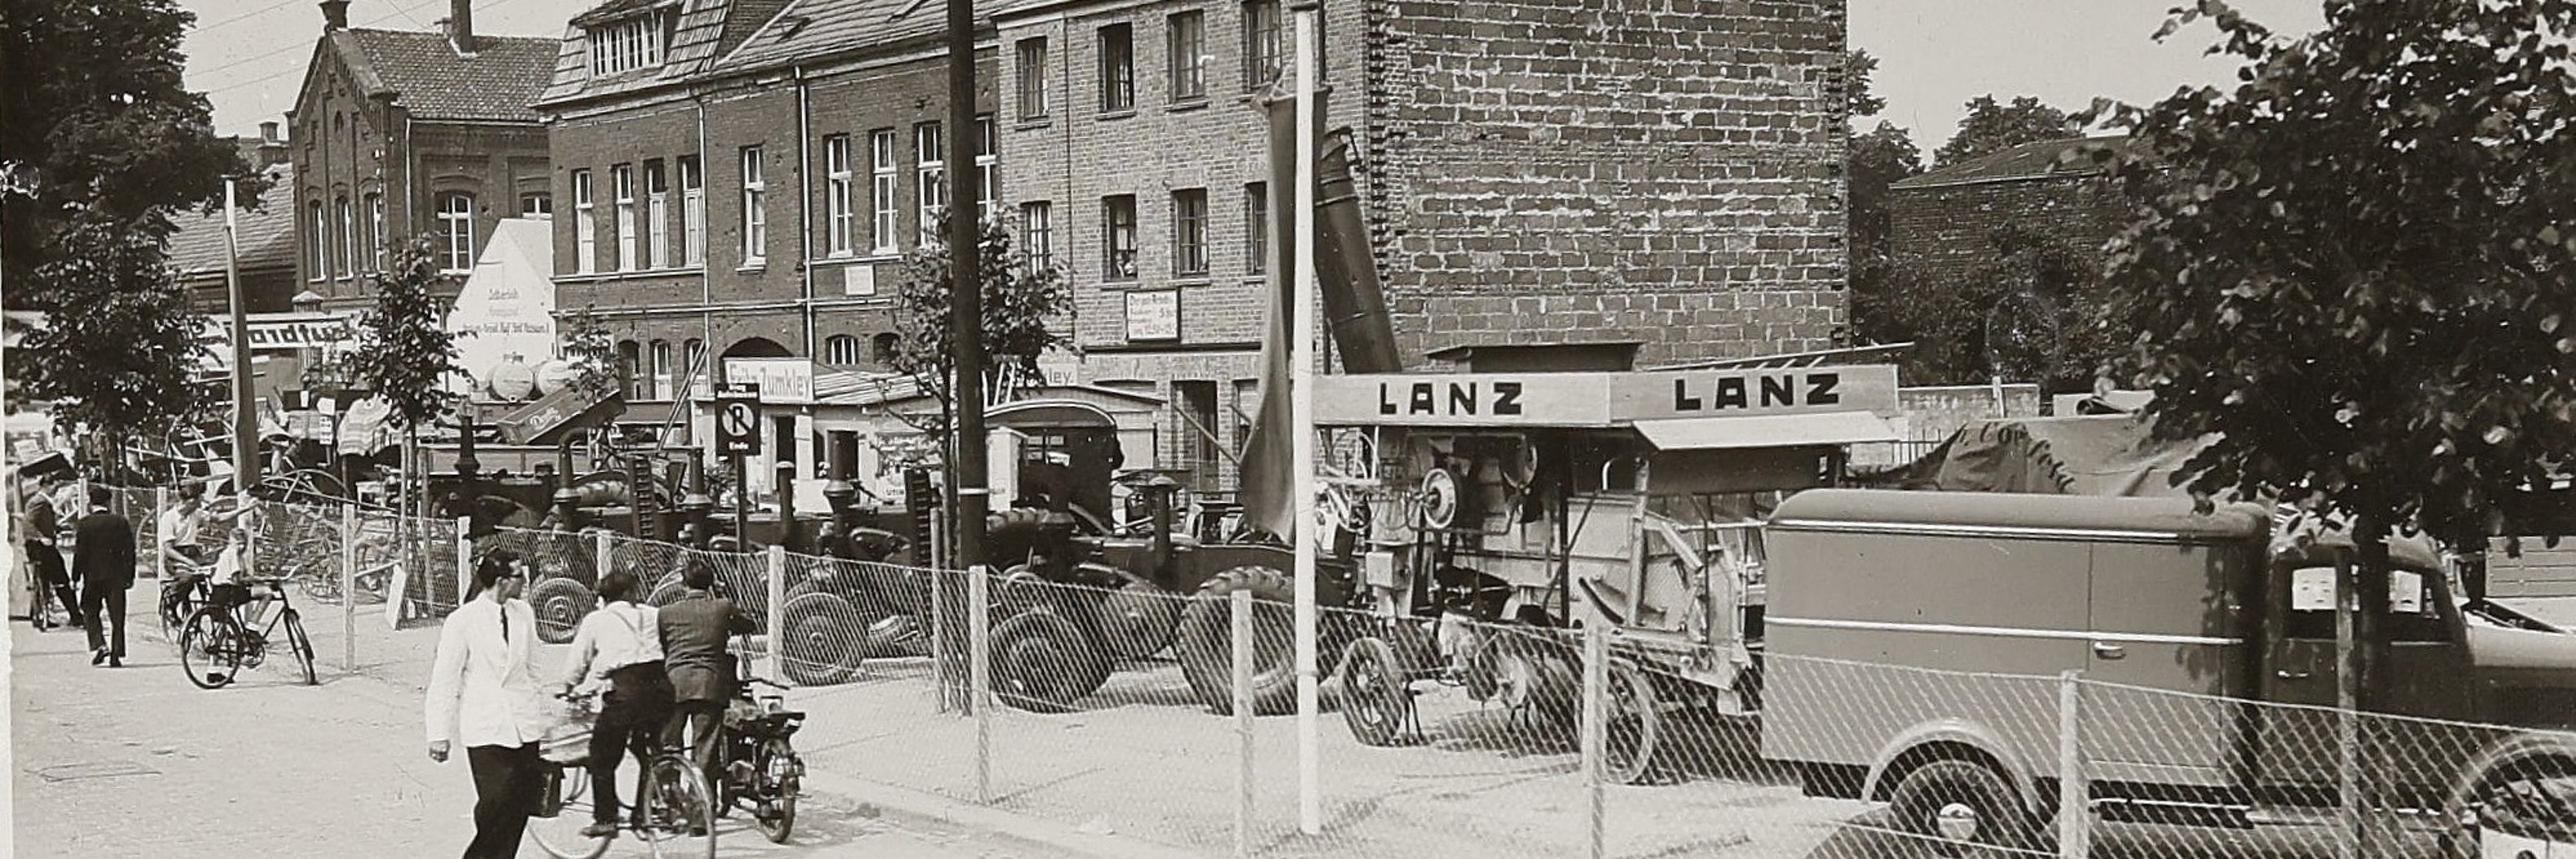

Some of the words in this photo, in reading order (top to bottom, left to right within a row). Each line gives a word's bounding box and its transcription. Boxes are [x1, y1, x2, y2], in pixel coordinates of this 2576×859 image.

[760, 367, 810, 399] Zumkley
[1380, 382, 1522, 415] LANZ
[1676, 373, 1839, 411] LANZ
